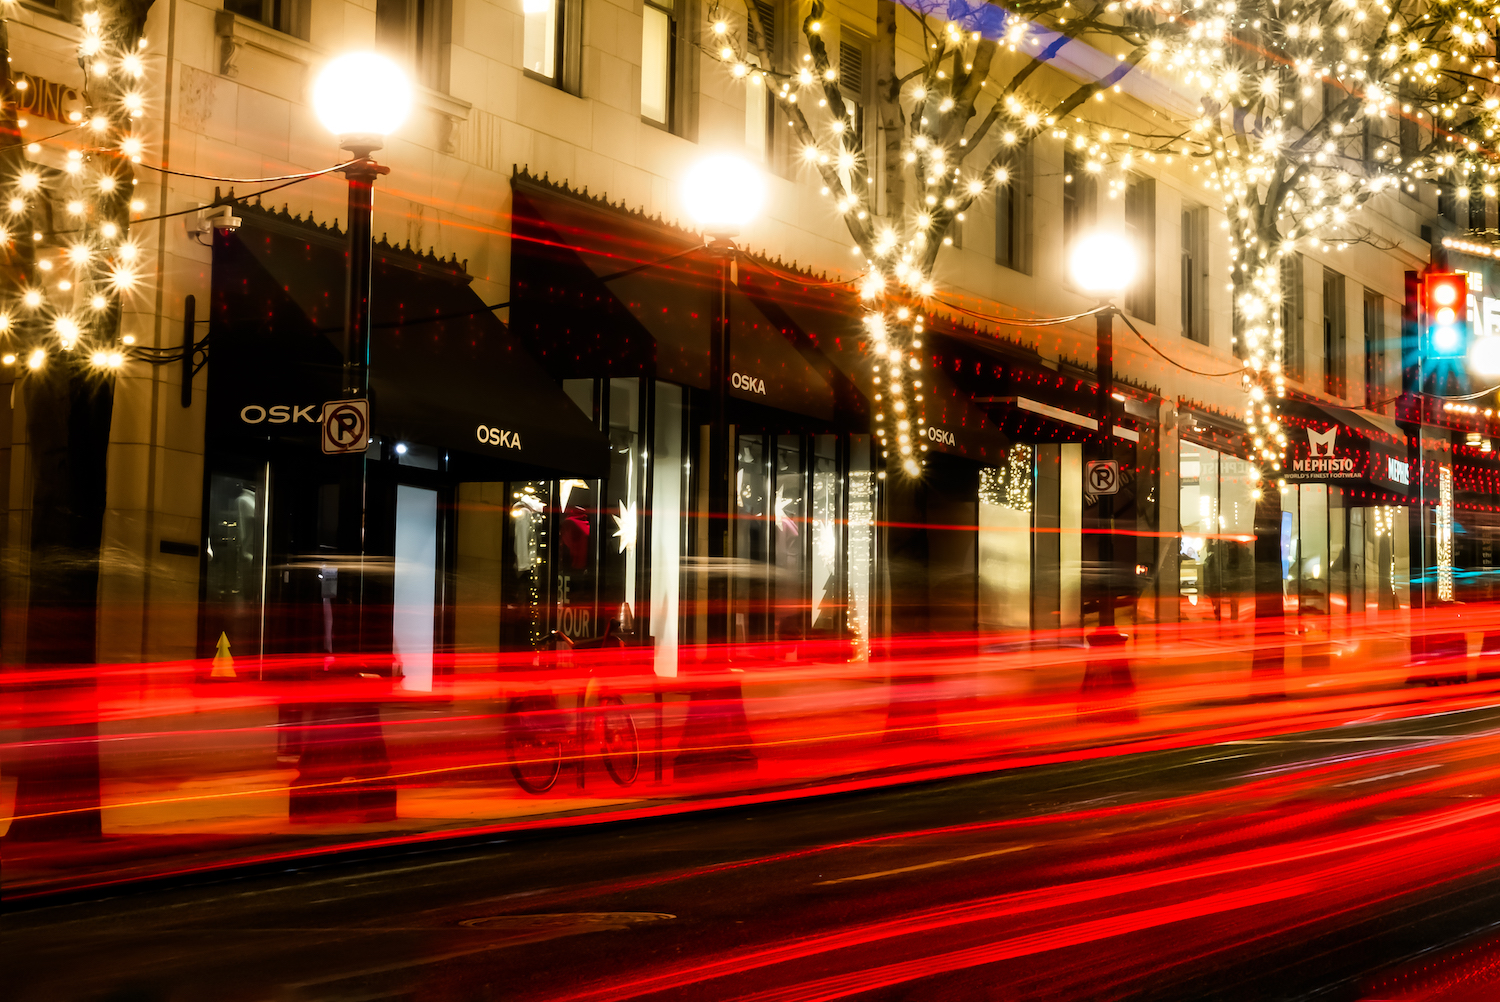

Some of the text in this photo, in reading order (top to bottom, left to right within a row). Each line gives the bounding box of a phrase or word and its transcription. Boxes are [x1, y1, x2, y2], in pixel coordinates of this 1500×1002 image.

[731, 372, 766, 395] OSKA
[240, 405, 323, 423] OSK
[477, 425, 521, 450] OSKA
[928, 426, 956, 447] OSKA
[1293, 458, 1353, 472] MEPHISTO
